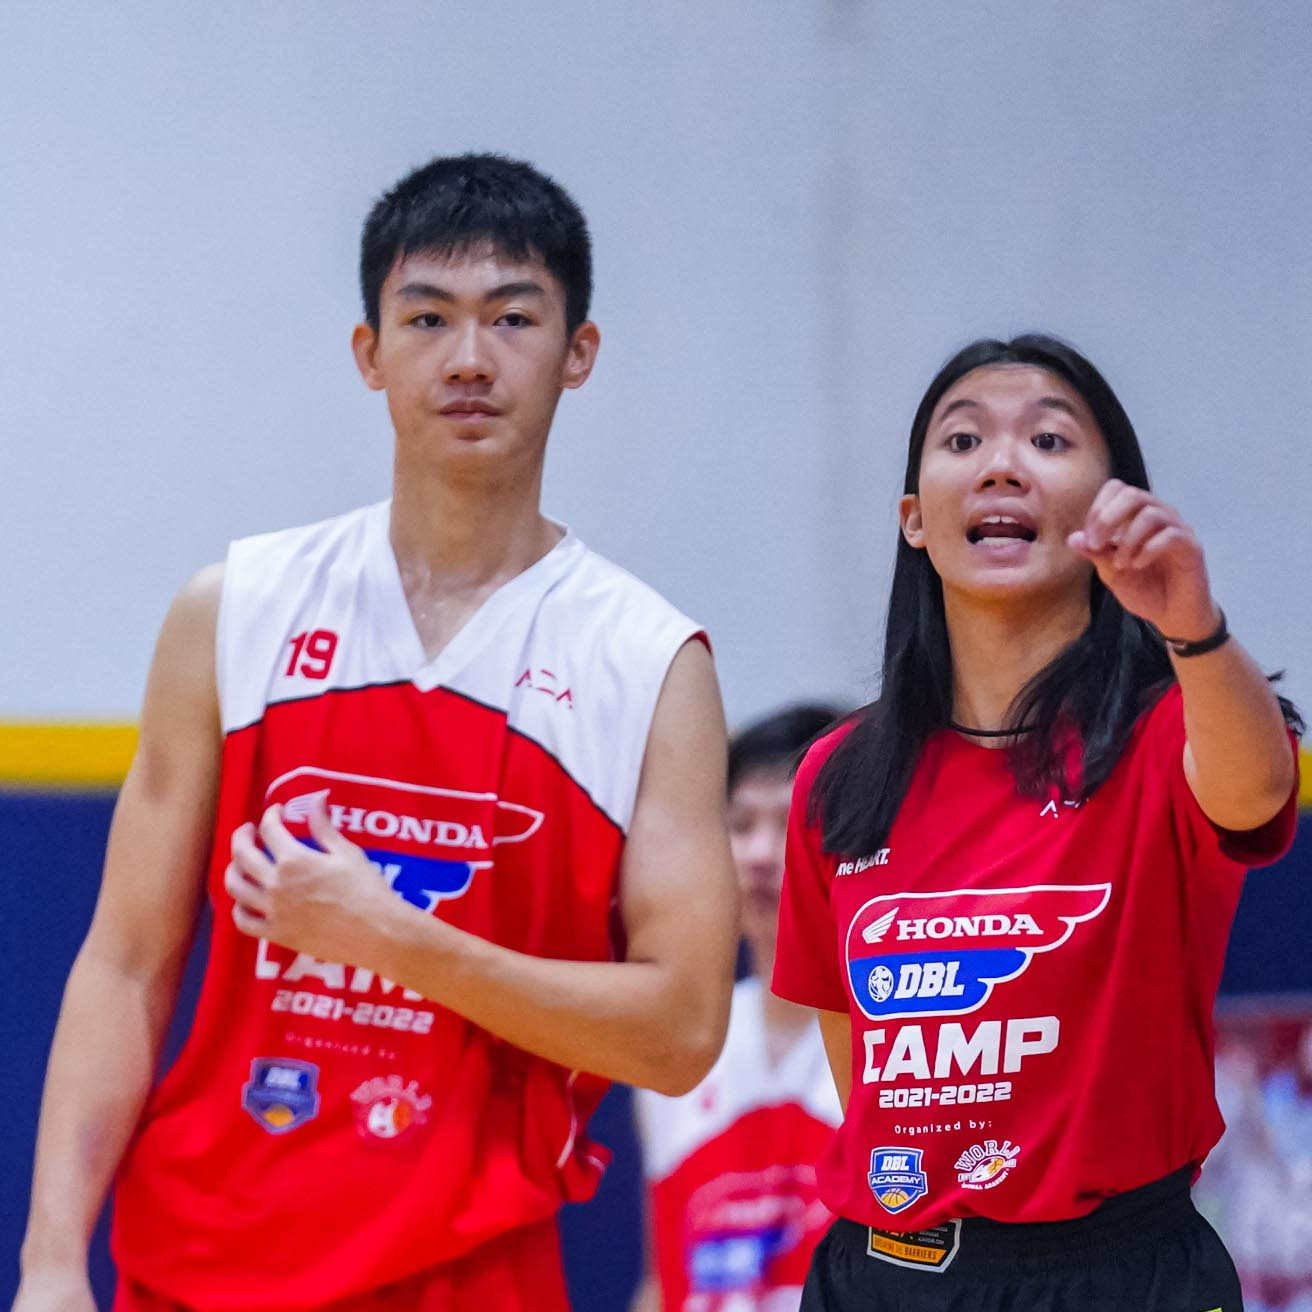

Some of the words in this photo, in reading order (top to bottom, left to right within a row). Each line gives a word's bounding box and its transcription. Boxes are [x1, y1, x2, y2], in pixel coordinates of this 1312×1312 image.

[285, 628, 339, 680] 19
[330, 804, 489, 849] HONDA
[835, 862, 854, 878] ne
[896, 914, 1044, 941] HONDA
[894, 961, 965, 1000] DBL
[271, 989, 435, 1035] 2021-2022
[863, 1016, 1060, 1085] CAMP
[879, 1081, 1012, 1109] 2021-2022
[894, 1120, 961, 1136] Organized
[969, 1119, 992, 1130] by:
[881, 1155, 910, 1172] DBL
[871, 1174, 921, 1186] ACADEMY
